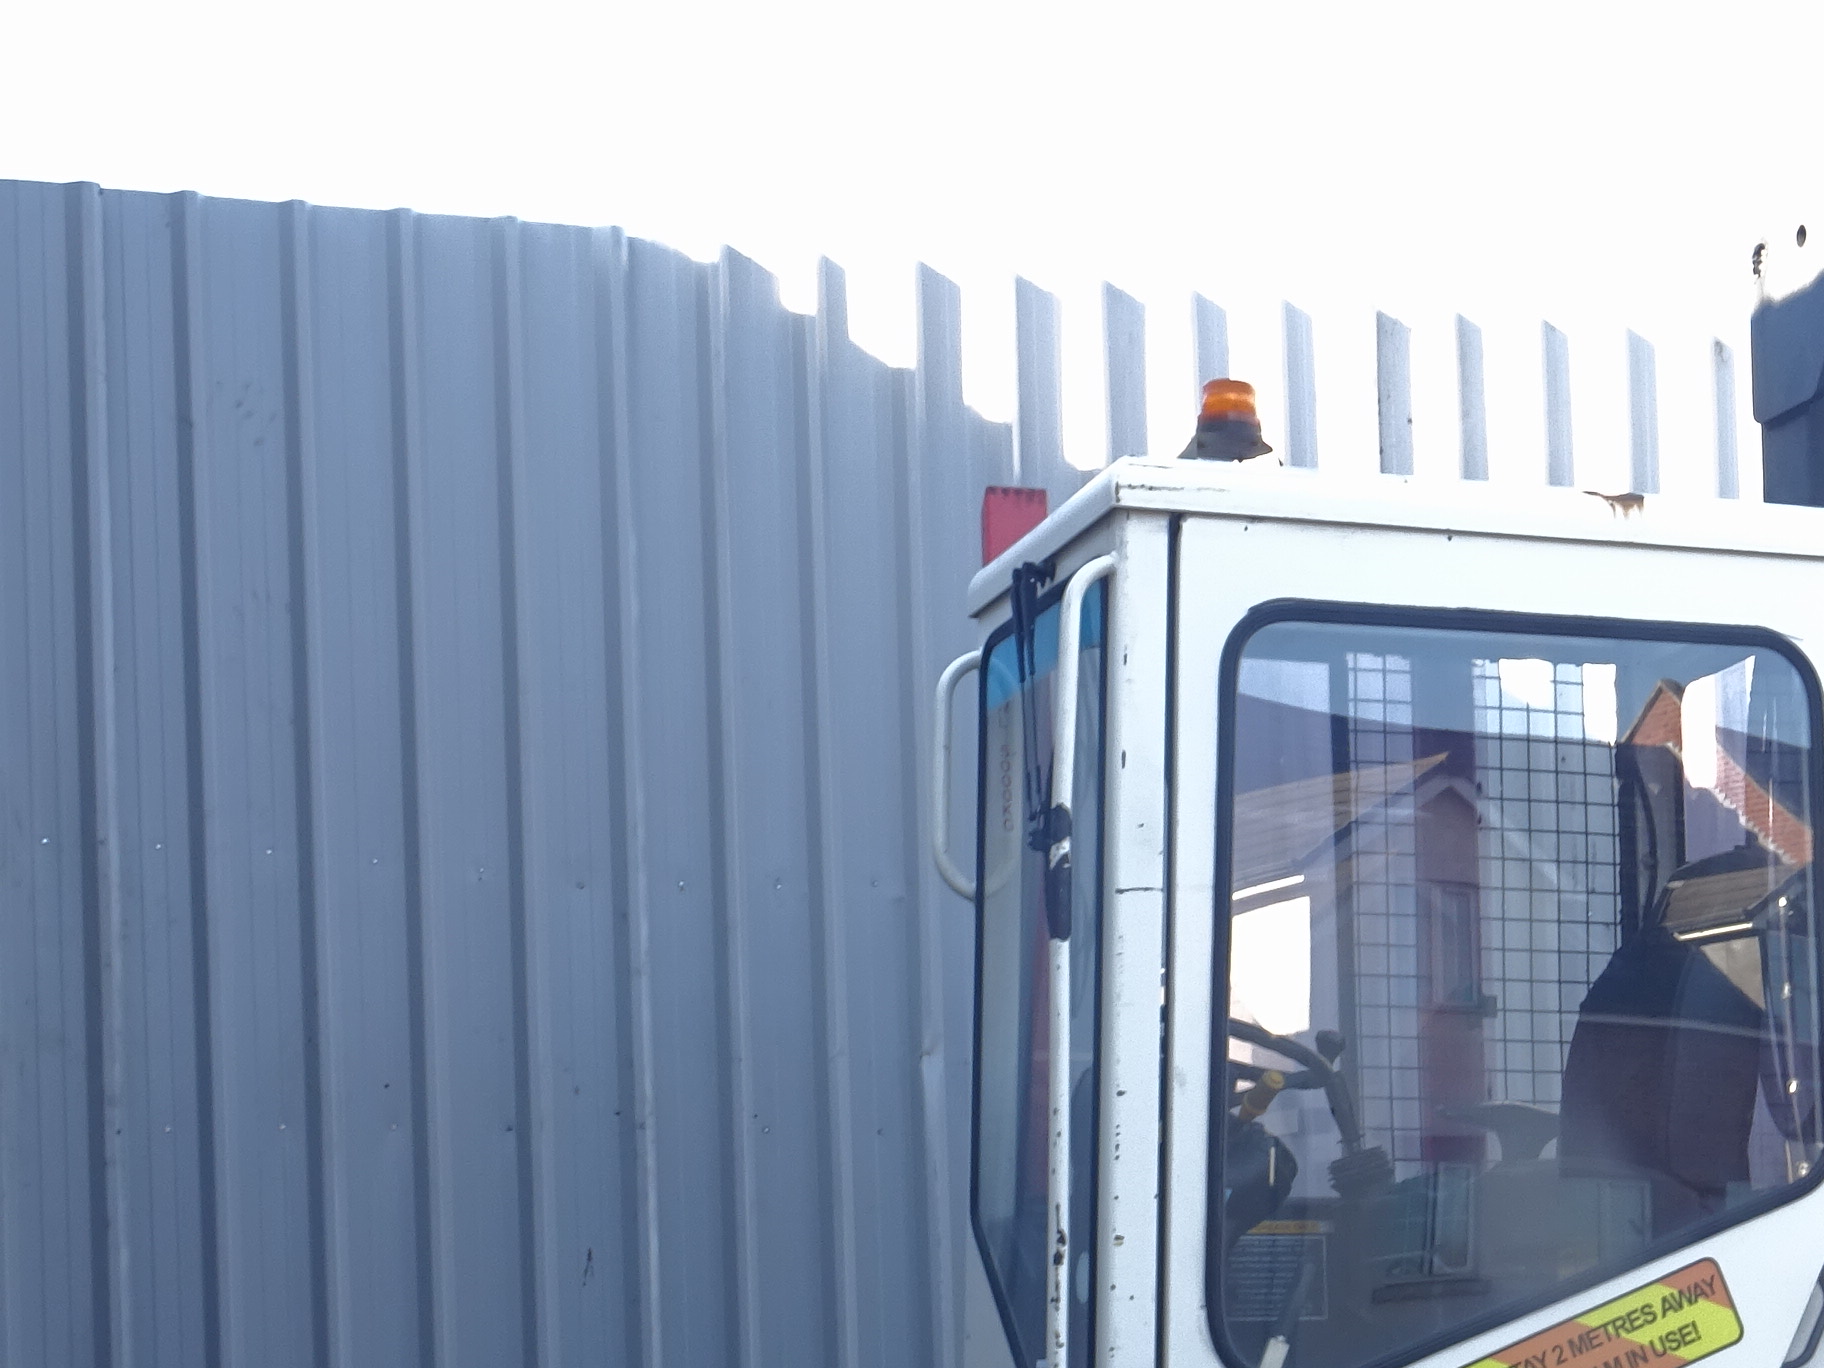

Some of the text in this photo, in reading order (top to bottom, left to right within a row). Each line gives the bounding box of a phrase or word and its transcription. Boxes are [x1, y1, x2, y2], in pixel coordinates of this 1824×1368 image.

[1555, 1344, 1568, 1366] 2
[1571, 1302, 1658, 1358] METRES
[1660, 1274, 1718, 1319] AWAY
[1649, 1320, 1702, 1359] USE!
